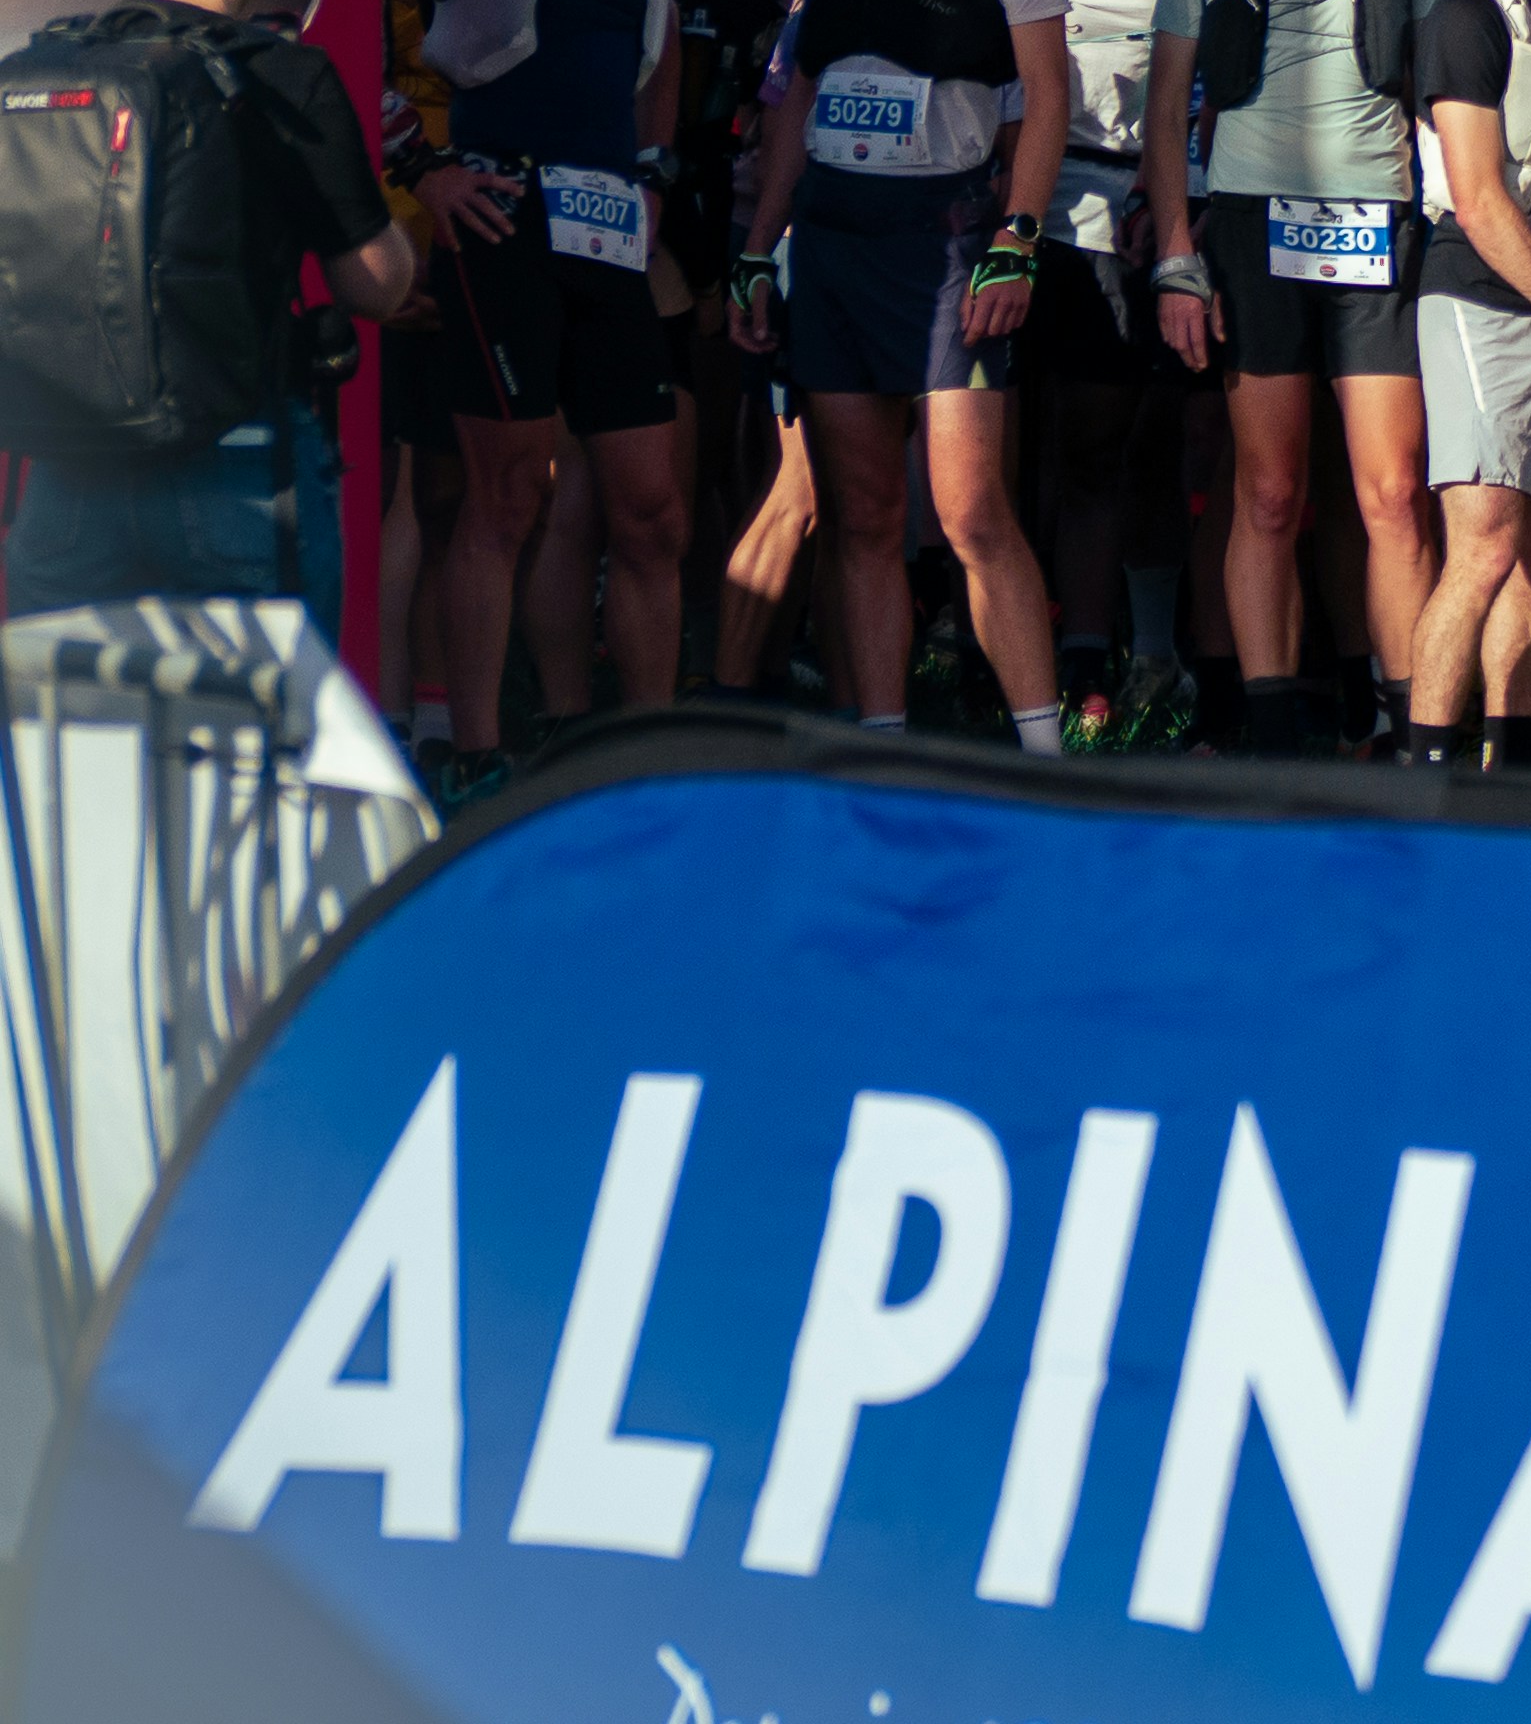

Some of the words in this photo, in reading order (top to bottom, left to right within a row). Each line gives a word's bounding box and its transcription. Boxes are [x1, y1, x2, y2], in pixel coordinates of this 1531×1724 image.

[827, 97, 903, 128] 50279
[559, 190, 629, 226] 50207
[1283, 224, 1377, 251] 50230
